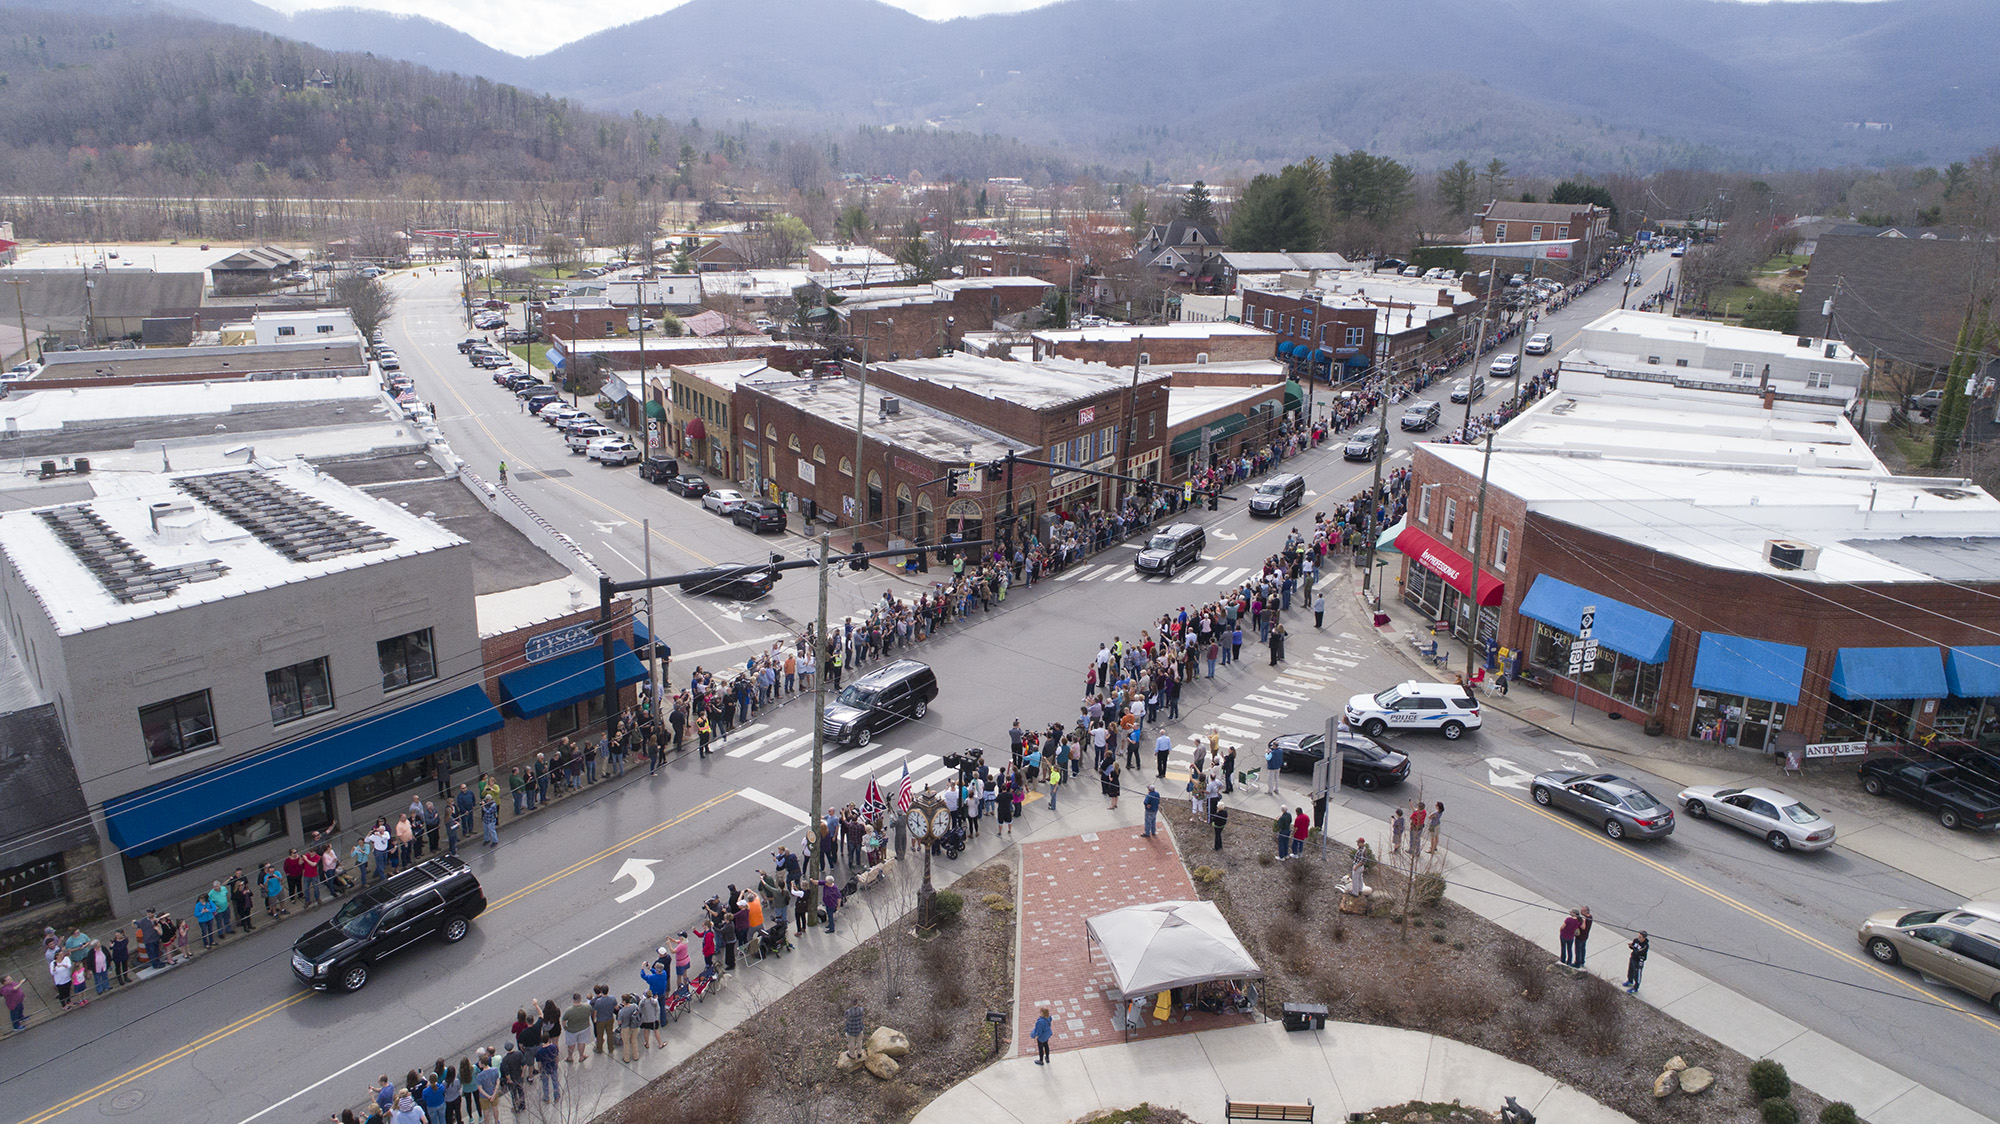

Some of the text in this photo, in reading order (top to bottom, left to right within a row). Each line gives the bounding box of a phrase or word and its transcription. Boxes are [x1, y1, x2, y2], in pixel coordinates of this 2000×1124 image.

[1585, 616, 1590, 626] 9
[1537, 623, 1554, 638] KEY
[1571, 652, 1581, 661] 70
[1586, 650, 1596, 659] 70
[1807, 744, 1851, 756] ANTIQUE
